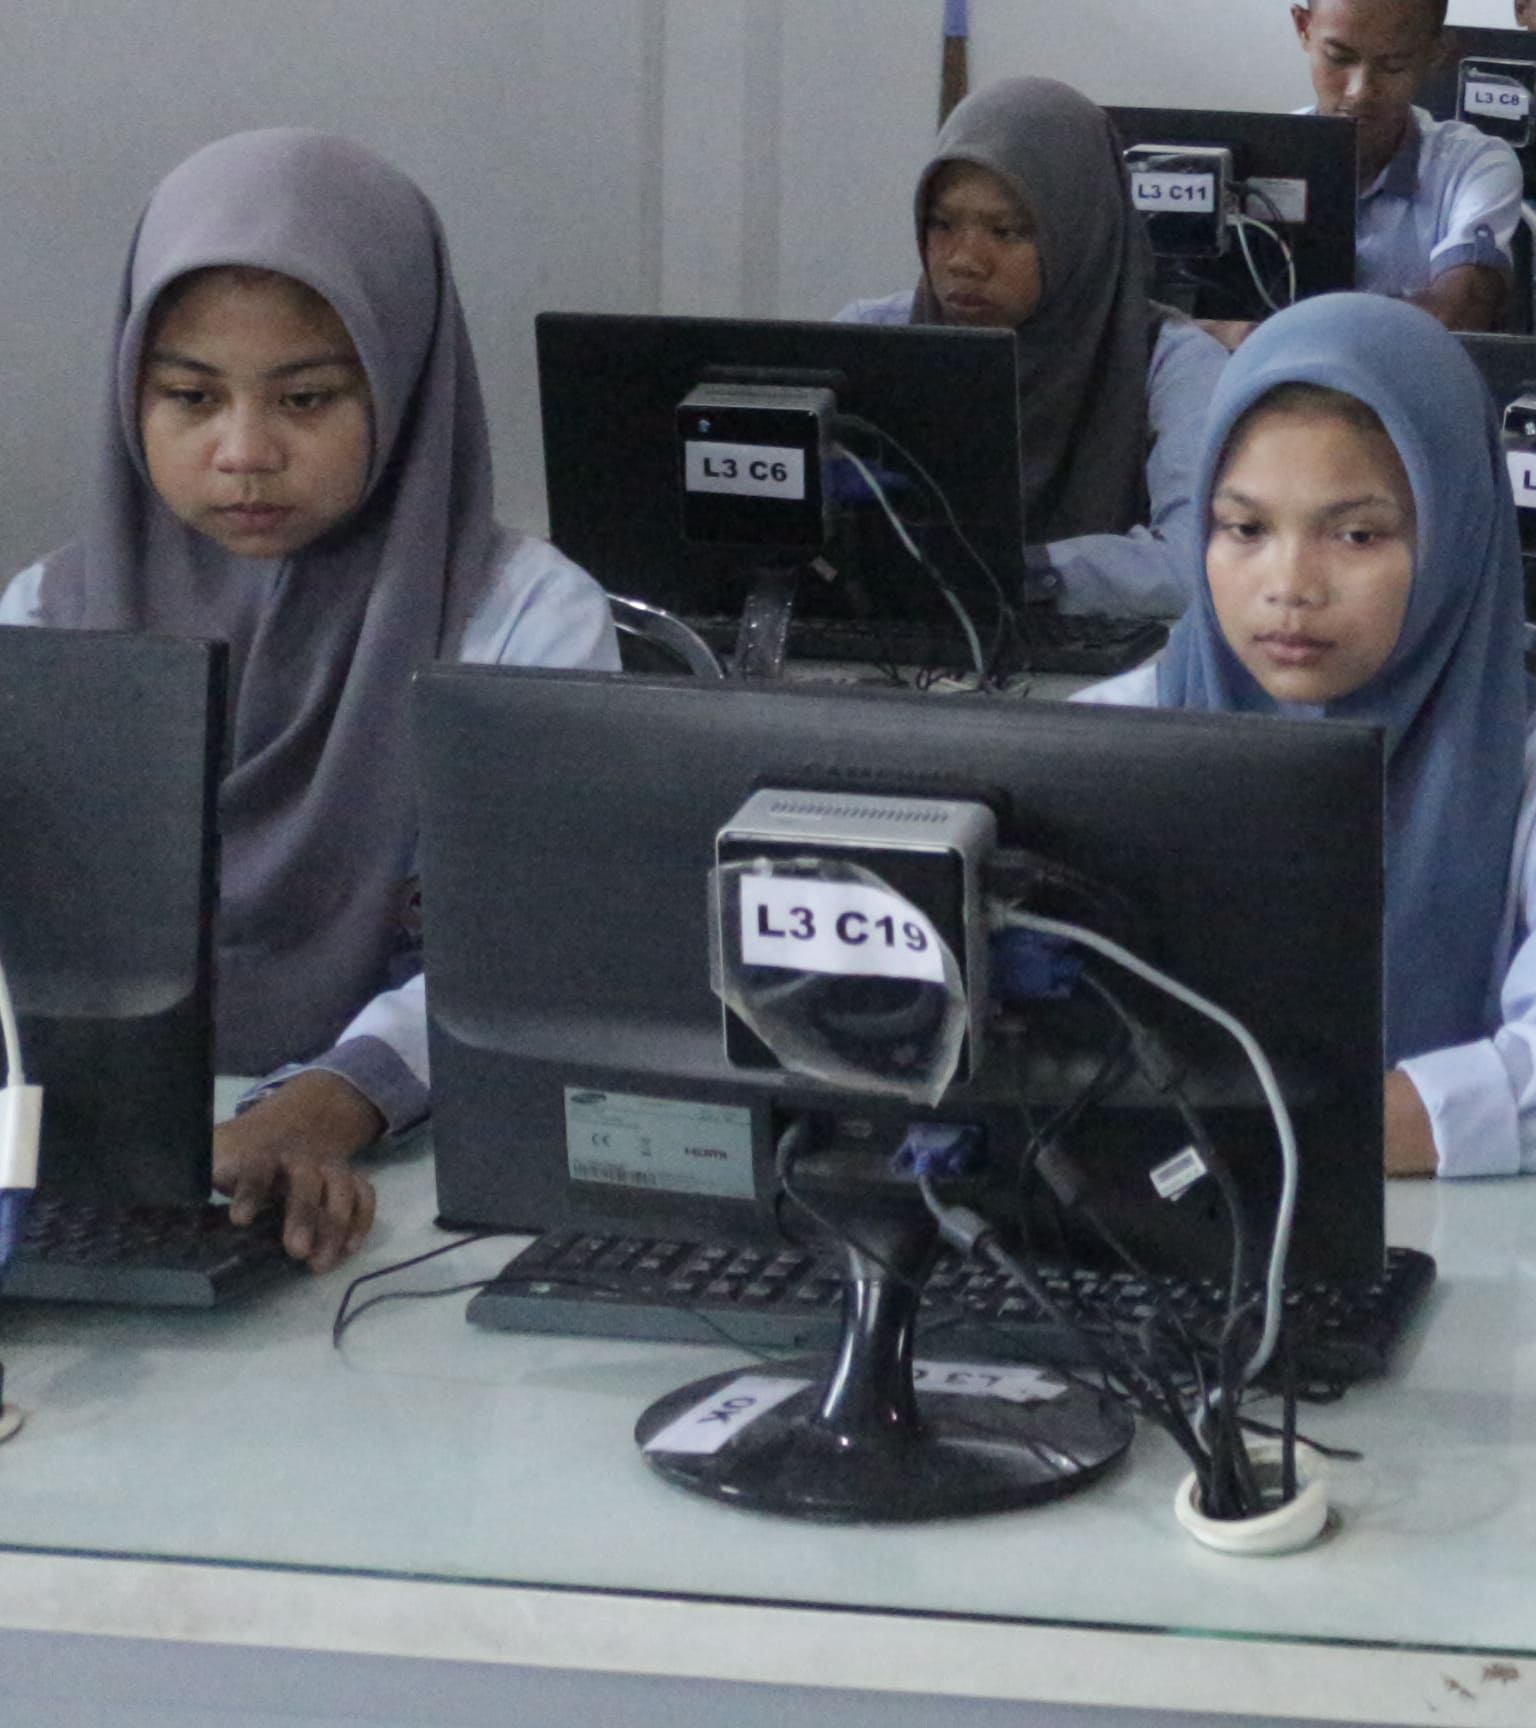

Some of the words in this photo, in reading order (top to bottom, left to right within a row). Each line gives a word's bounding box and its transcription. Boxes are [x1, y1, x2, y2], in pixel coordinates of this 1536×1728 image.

[1473, 91, 1494, 106] L3
[1498, 92, 1521, 107] C8
[1137, 183, 1163, 200] L3
[1168, 184, 1207, 201] C11
[703, 457, 738, 479] L3
[748, 459, 788, 483] C6
[757, 903, 817, 942] L3
[835, 910, 930, 954] C19
[697, 1396, 756, 1425] OK
